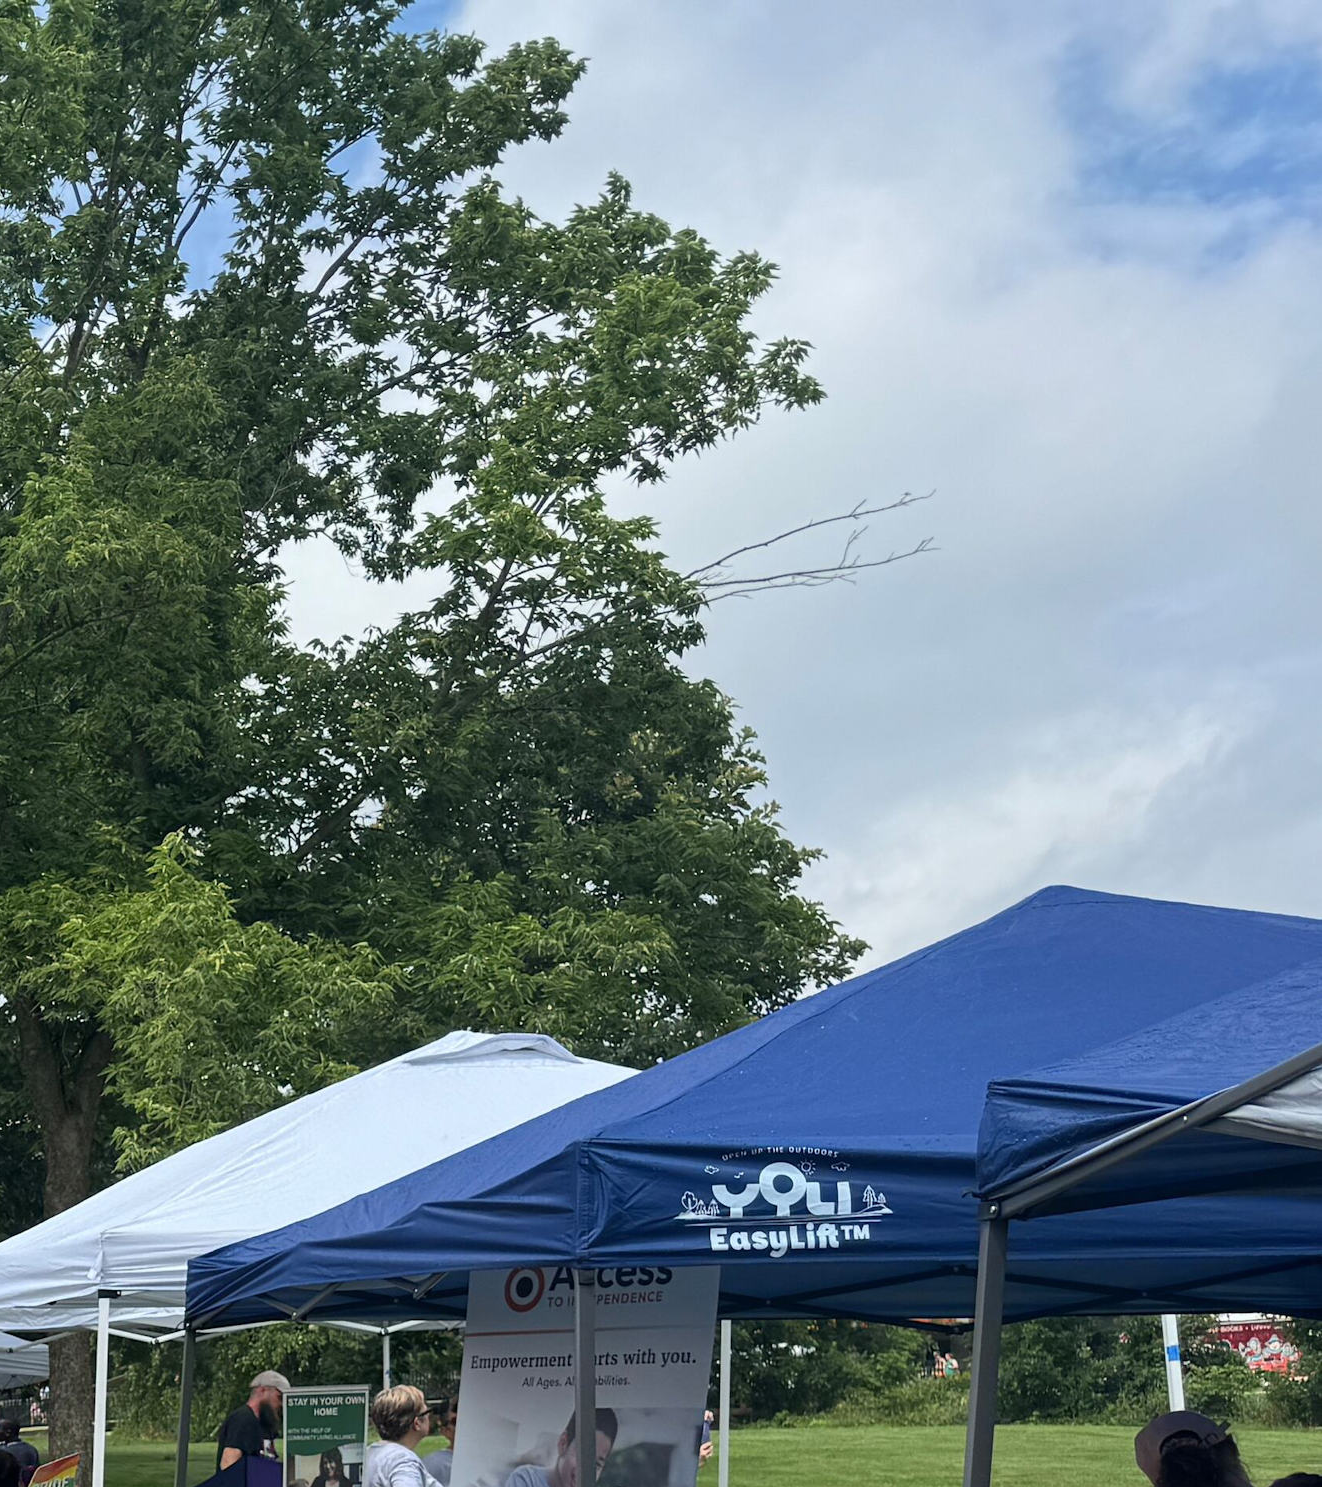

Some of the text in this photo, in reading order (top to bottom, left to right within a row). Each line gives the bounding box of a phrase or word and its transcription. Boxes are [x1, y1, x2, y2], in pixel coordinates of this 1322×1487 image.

[789, 1146, 839, 1158] OUTDOORS
[711, 1161, 852, 1218] YOLI
[549, 1267, 673, 1291] Acess
[548, 1291, 663, 1307] TO IPENDENCE
[471, 1349, 697, 1372] Empowerment rts with you.
[522, 1377, 534, 1387] All
[536, 1376, 561, 1389] Ages.
[287, 1395, 365, 1407] STAY IN YOUR OWN
[313, 1407, 338, 1416] HOME
